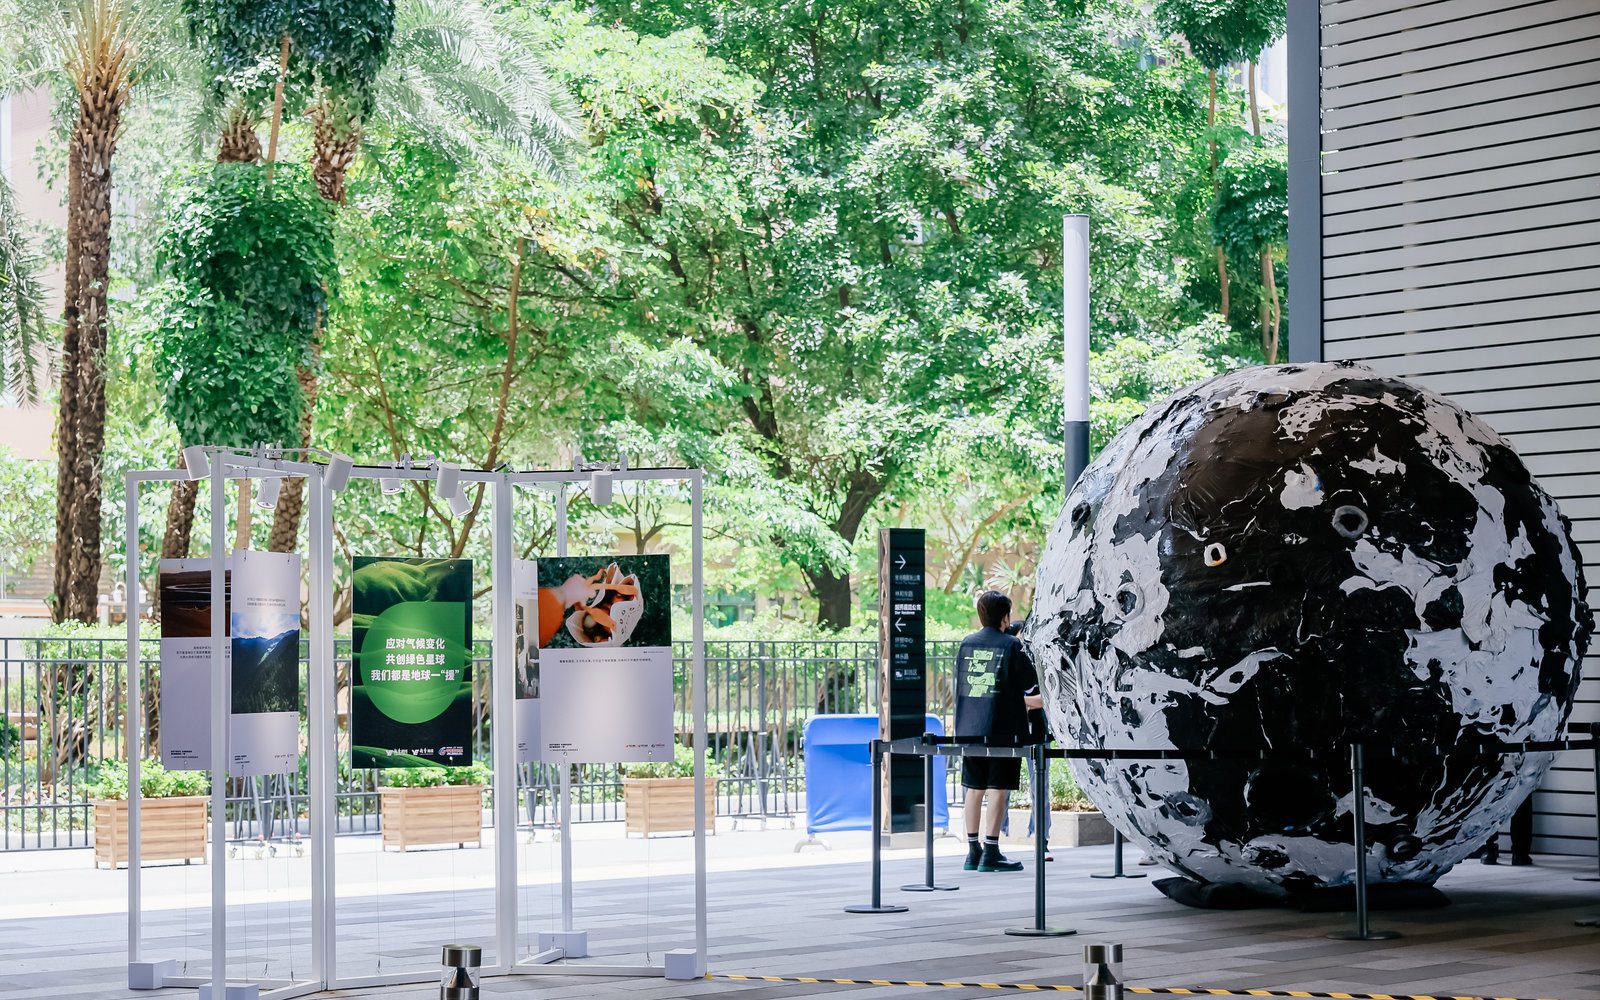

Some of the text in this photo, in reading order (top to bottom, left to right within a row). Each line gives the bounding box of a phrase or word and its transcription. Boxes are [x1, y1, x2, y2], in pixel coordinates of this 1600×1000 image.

[386, 638, 445, 650] 应对气候变化
[386, 654, 445, 665] 共创绿色星球
